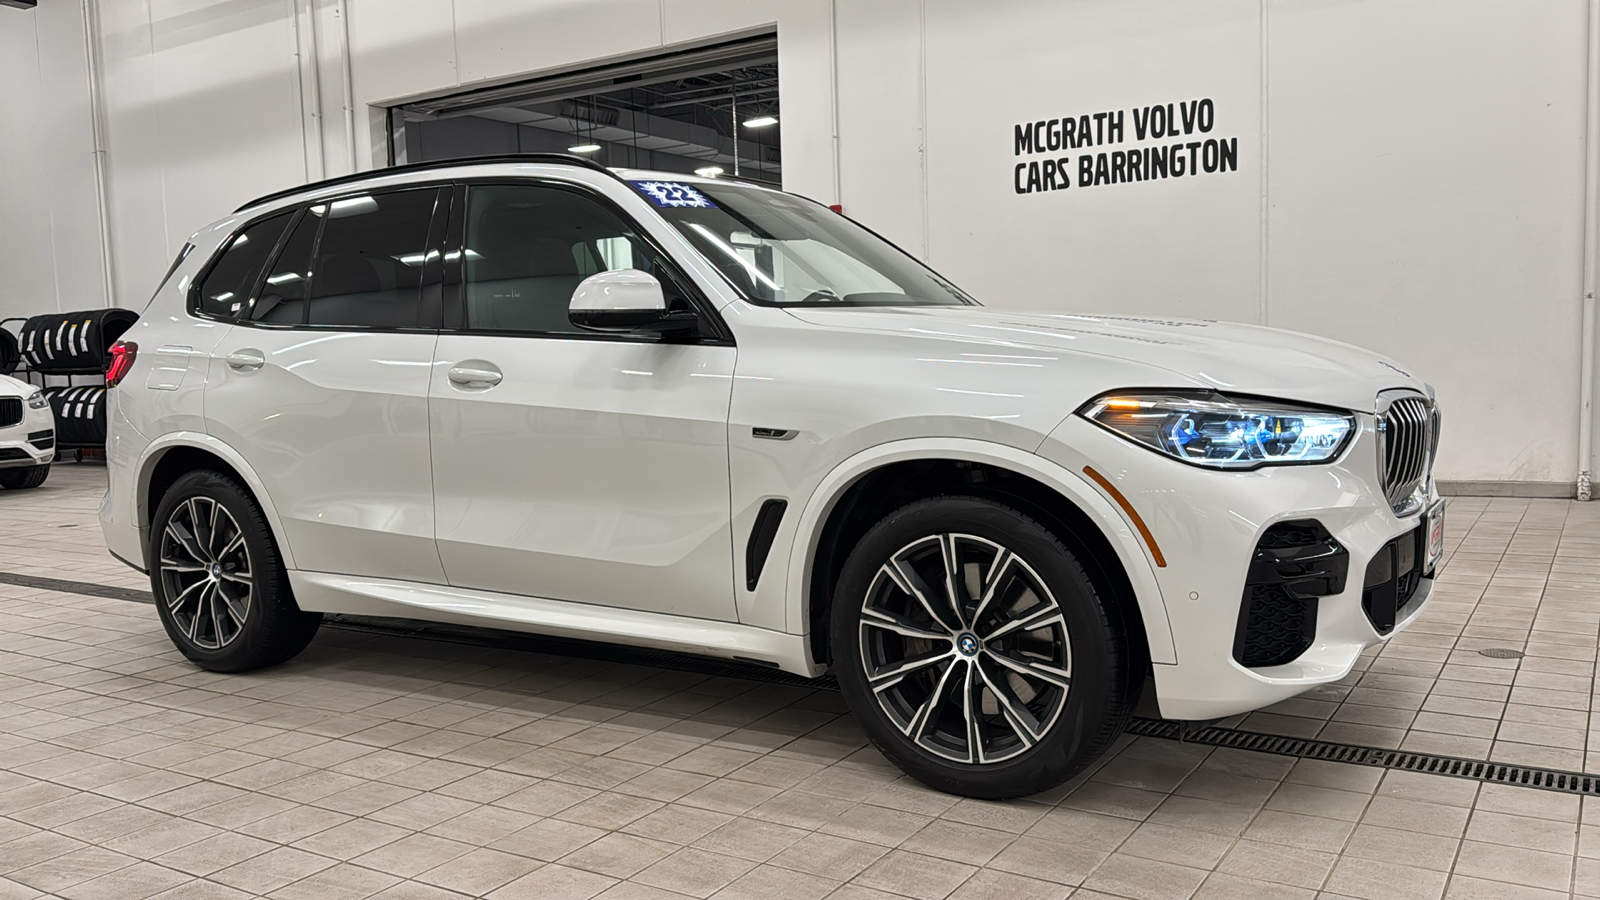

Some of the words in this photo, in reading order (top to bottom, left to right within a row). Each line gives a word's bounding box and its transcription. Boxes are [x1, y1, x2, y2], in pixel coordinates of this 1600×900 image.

[1014, 110, 1124, 156] MCGRATH
[1132, 98, 1214, 141] VOLVO
[656, 186, 697, 202] 22
[1014, 157, 1070, 195] CARS
[1078, 137, 1238, 188] BARRINGTON
